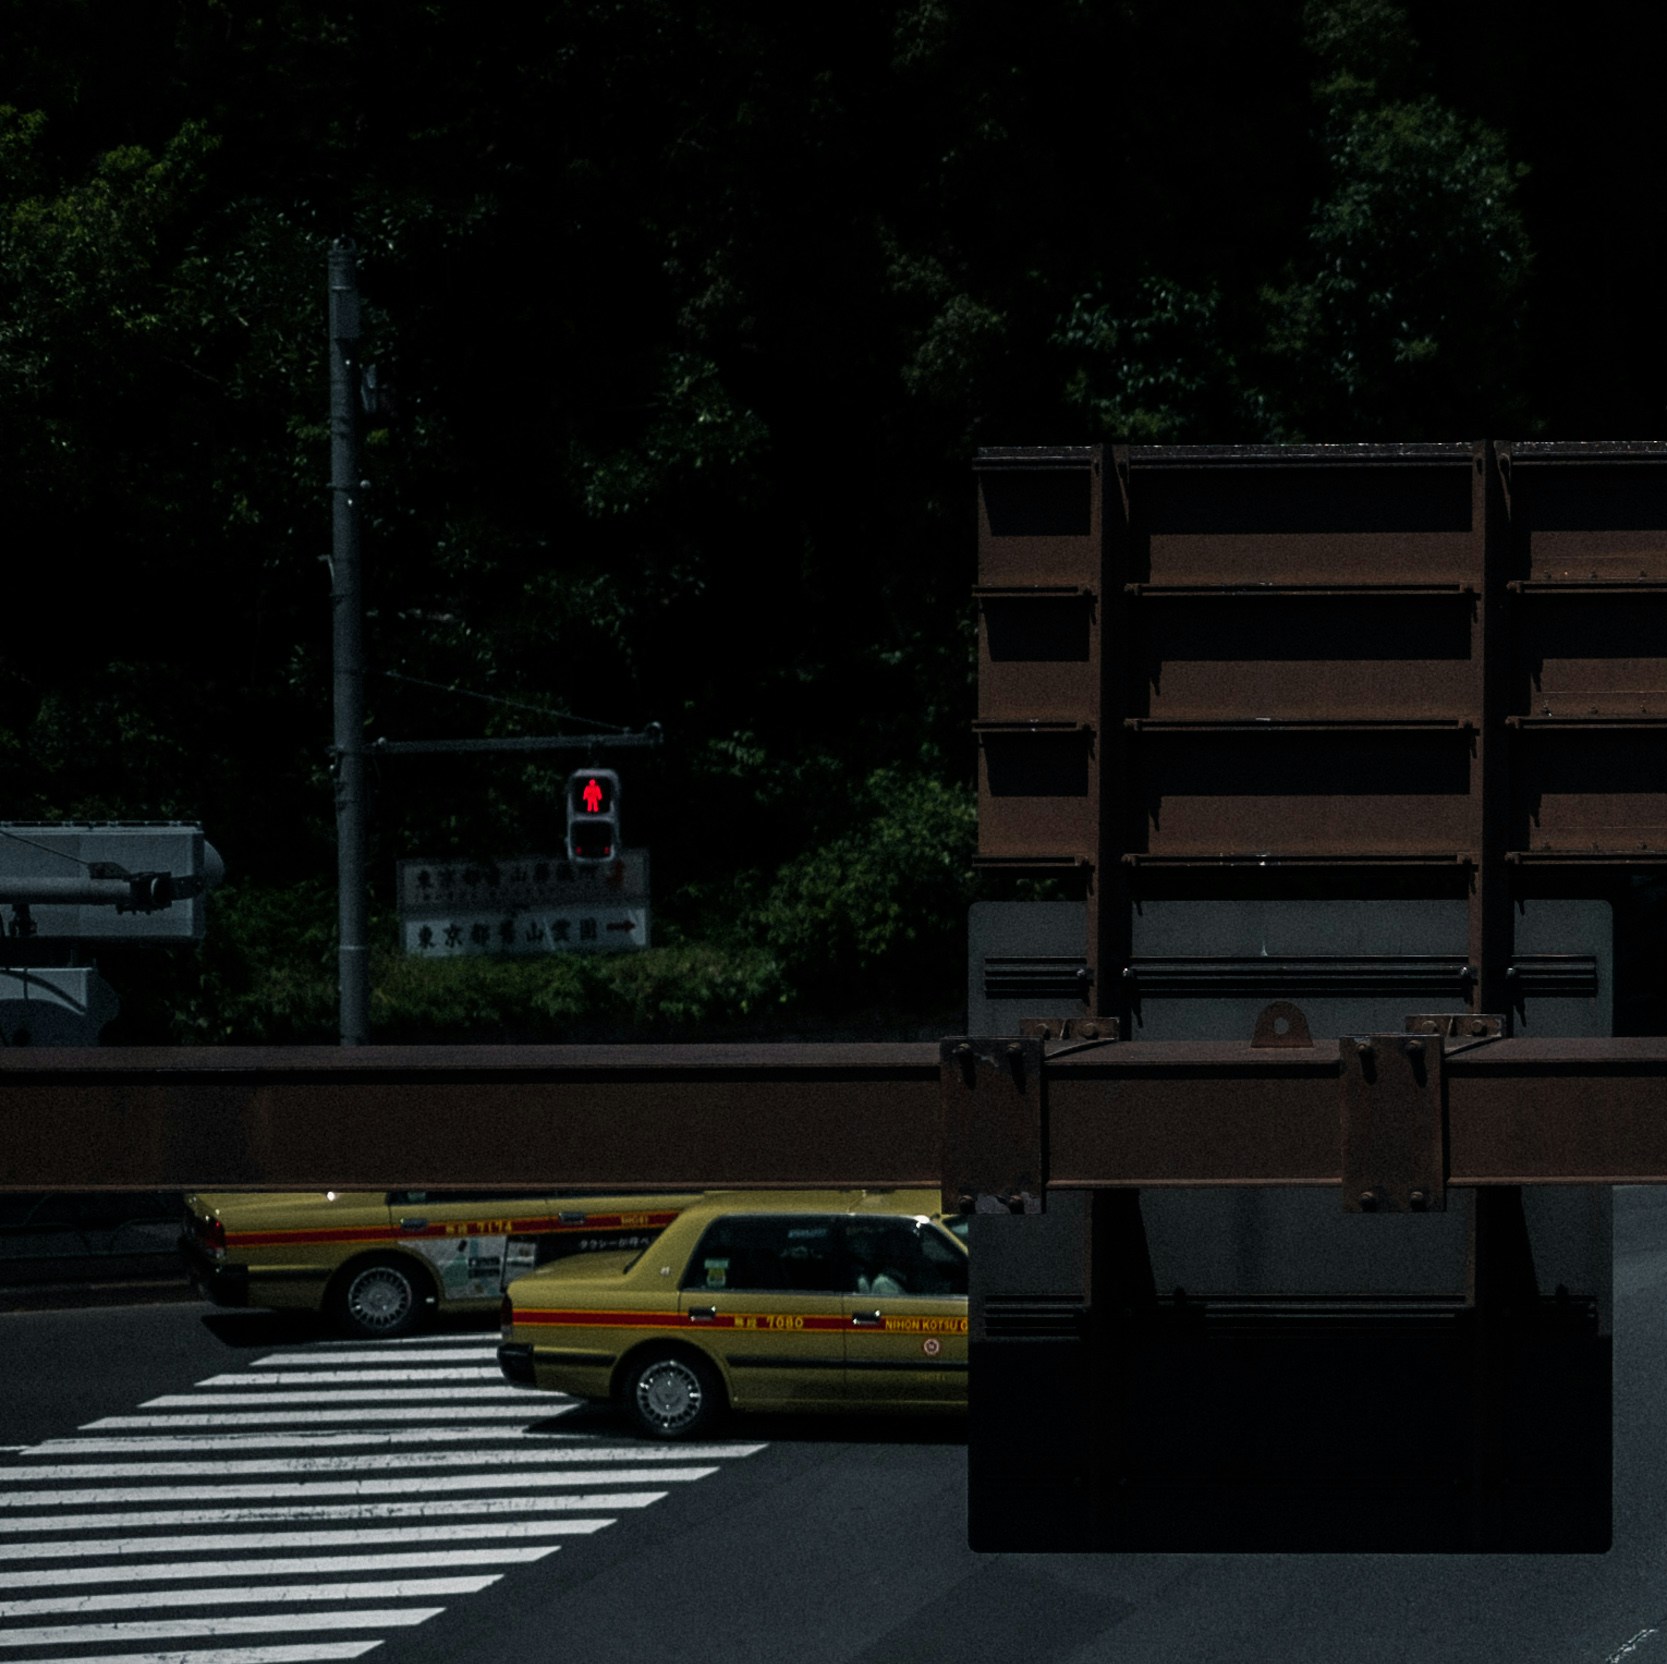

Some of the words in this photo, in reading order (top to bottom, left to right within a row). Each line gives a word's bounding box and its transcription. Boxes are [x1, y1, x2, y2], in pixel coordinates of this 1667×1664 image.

[419, 918, 597, 948] 東京都青山霊園
[885, 1318, 920, 1331] NIHON
[923, 1318, 957, 1331] KOTSU
